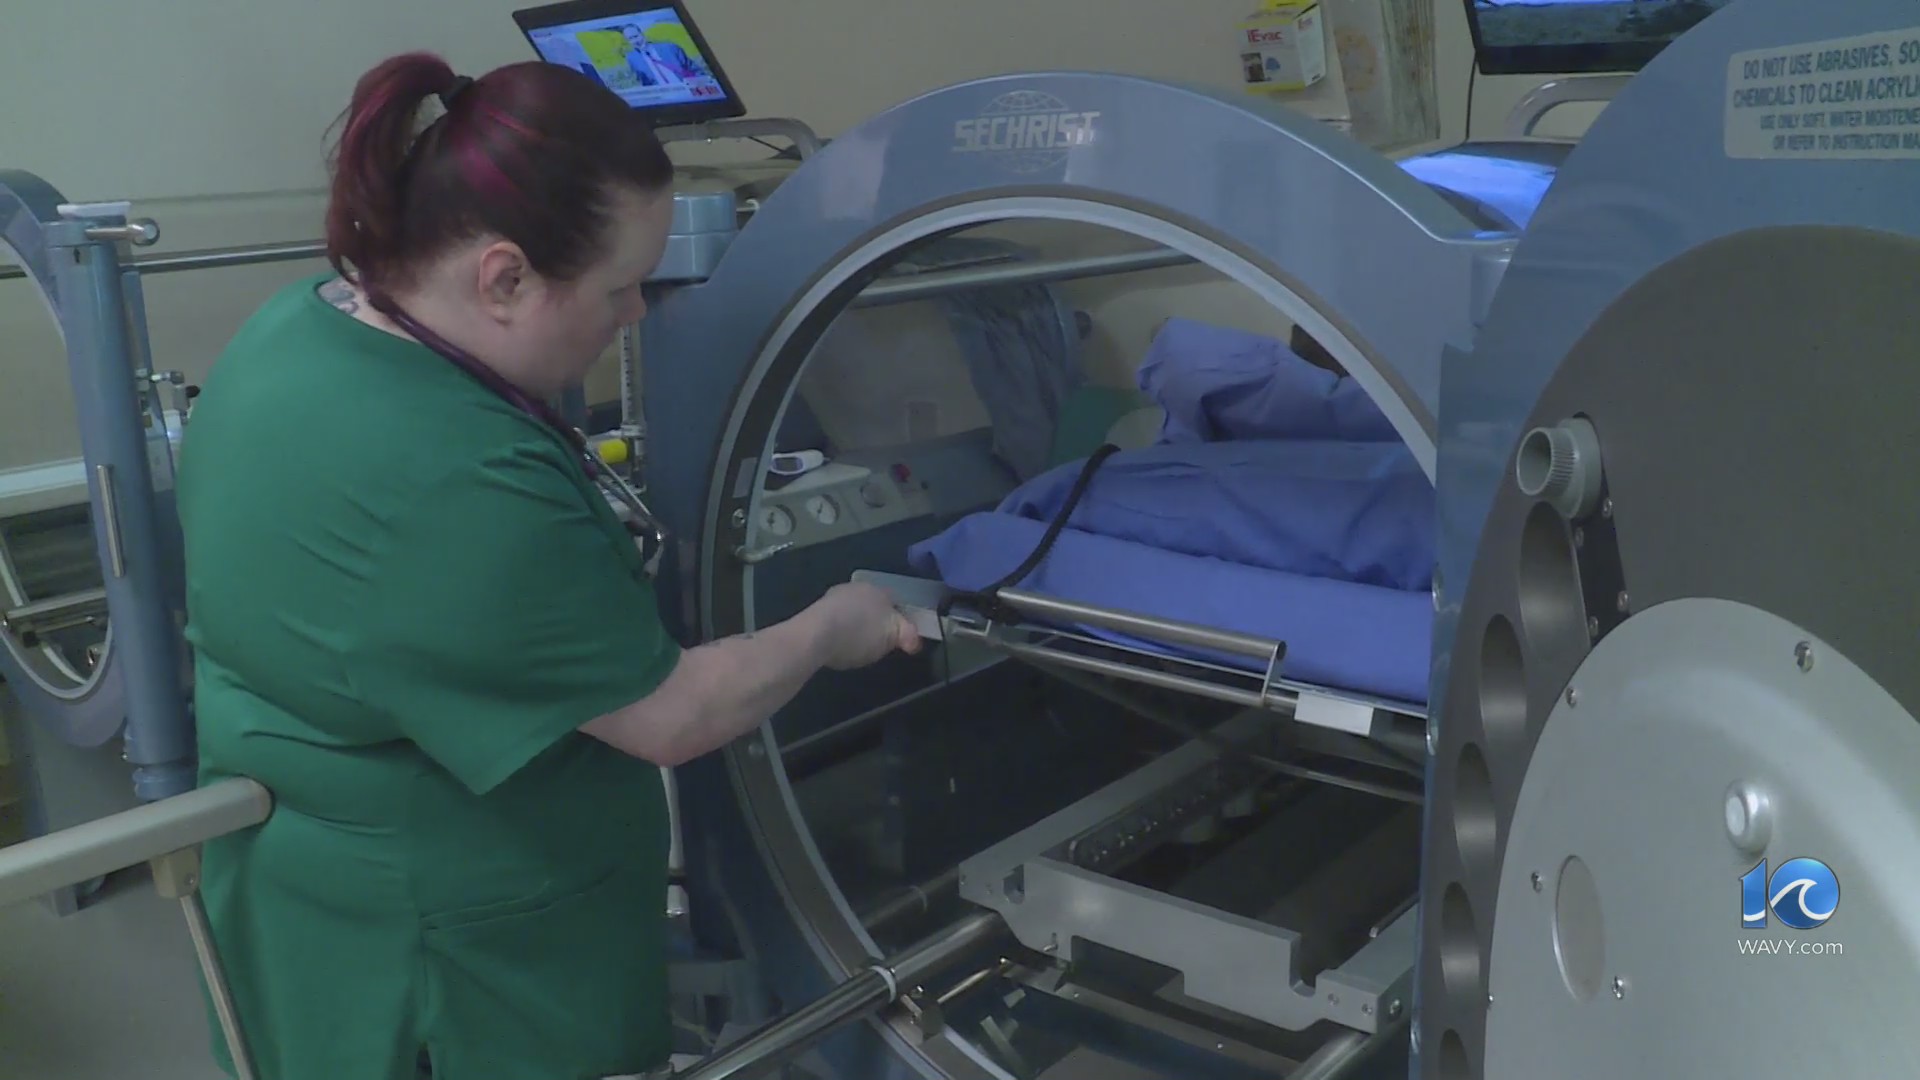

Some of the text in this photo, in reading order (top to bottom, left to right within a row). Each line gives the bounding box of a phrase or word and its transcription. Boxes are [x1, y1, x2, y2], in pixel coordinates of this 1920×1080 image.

[1744, 60, 1760, 80] DO
[1762, 56, 1787, 78] NOT
[1789, 52, 1813, 75] USE
[1733, 85, 1796, 108] CHEMICALS
[1800, 84, 1816, 104] TO
[1819, 80, 1863, 103] CLEAN
[952, 111, 1100, 152] SECHRIST
